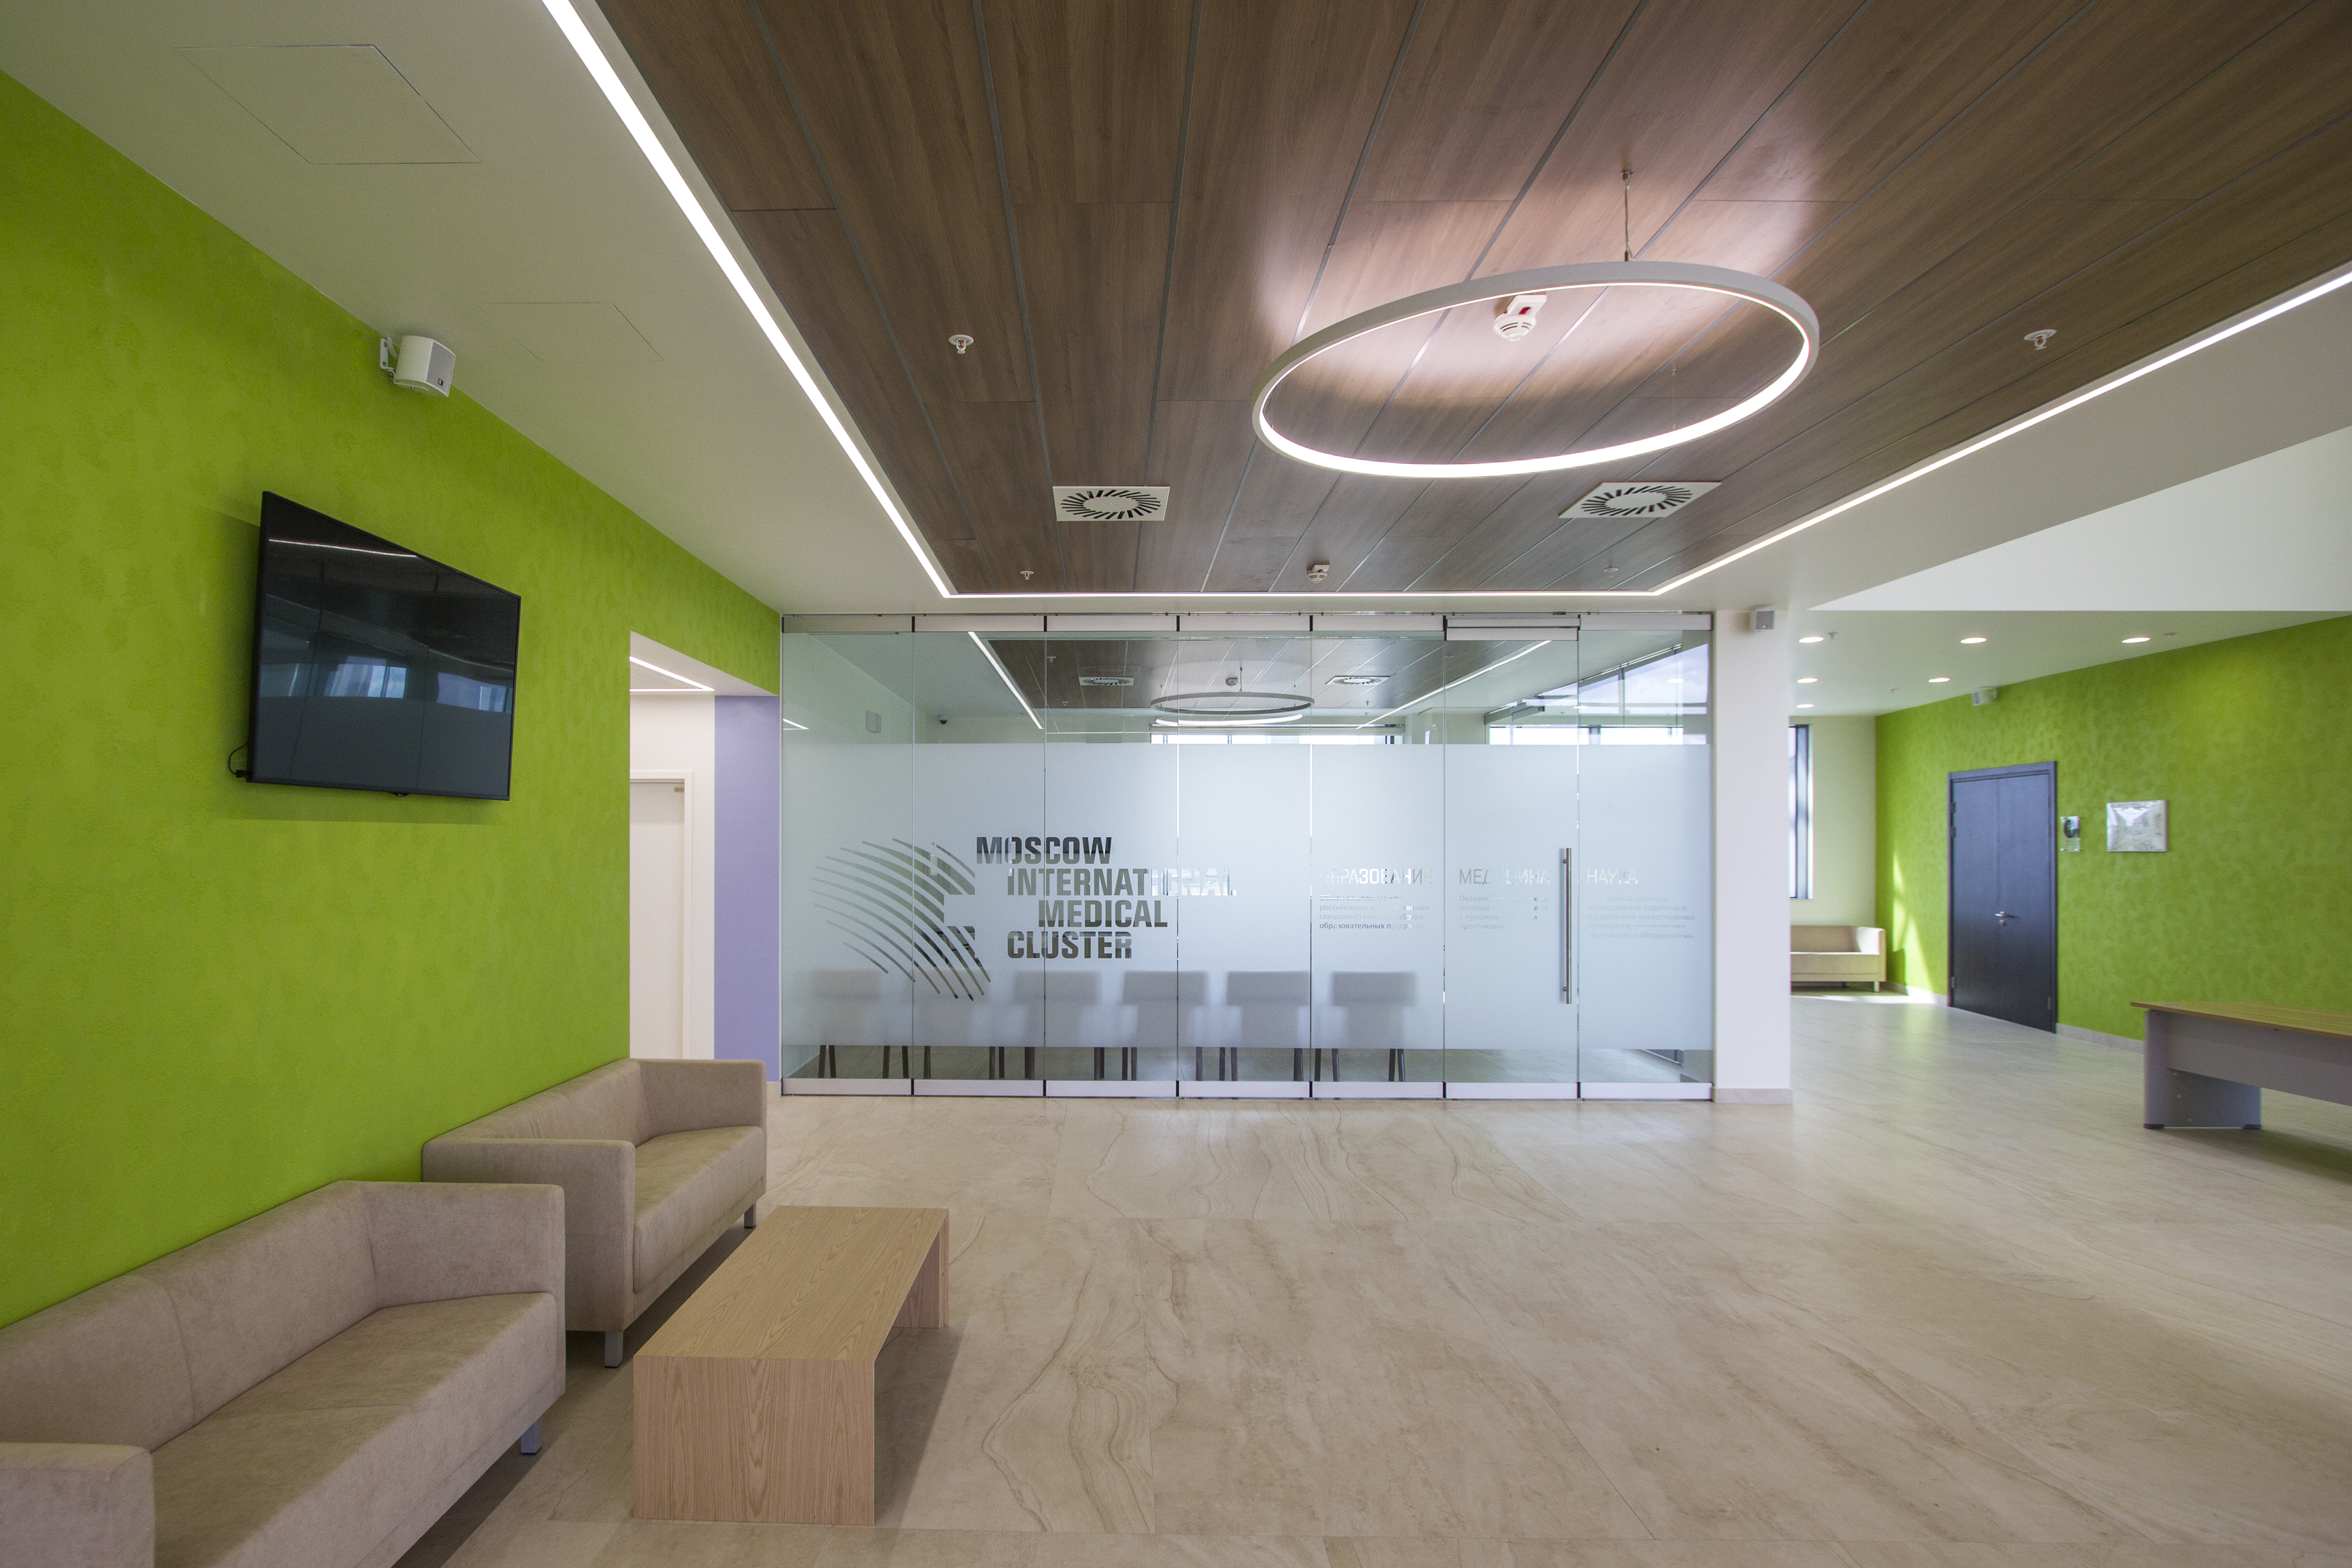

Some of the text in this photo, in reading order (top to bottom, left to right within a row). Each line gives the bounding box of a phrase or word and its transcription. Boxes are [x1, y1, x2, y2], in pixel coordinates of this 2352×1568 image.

[976, 837, 1112, 864] MOSCOW
[1007, 868, 1237, 896] INTERNATIONAL
[1319, 868, 1433, 884] ОБРАЗОВАНИЕ
[1038, 900, 1167, 927] MEDICAL
[1319, 922, 1385, 930] образовательных
[1007, 931, 1132, 959] CLUSTER
